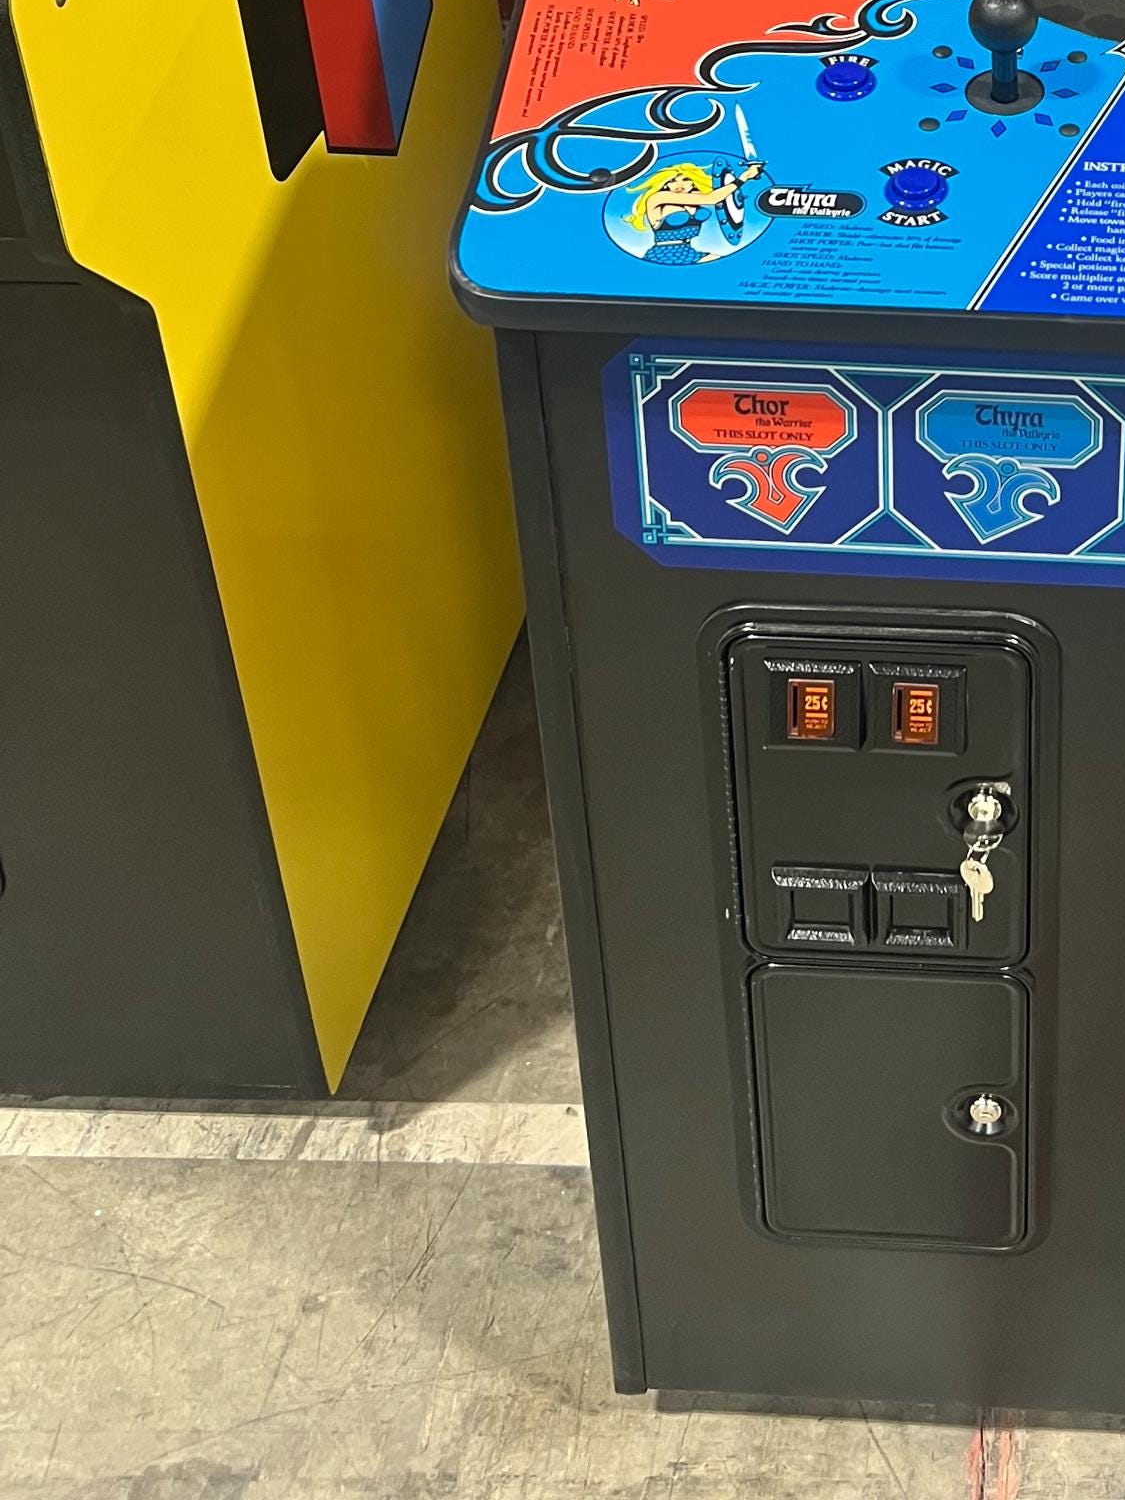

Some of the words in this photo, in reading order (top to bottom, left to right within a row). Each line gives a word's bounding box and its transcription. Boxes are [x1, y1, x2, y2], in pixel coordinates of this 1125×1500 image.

[828, 55, 871, 67] FIRE
[886, 159, 952, 177] MAGIC
[1084, 180, 1108, 189] Each
[1075, 188, 1112, 198] Players
[768, 188, 837, 215] Thyra
[1076, 199, 1102, 207] Hold
[810, 207, 851, 218] Valkyrie
[1071, 207, 1109, 216] Release
[882, 210, 941, 227] START
[1067, 215, 1098, 224] Move
[1090, 235, 1116, 244] Food
[1055, 243, 1092, 252] Collect
[1095, 246, 1125, 255] magic
[1075, 253, 1112, 262] Collect
[1039, 260, 1076, 271] Special
[1078, 263, 1117, 272] potions
[1029, 270, 1058, 280] Score
[1060, 272, 1114, 283] multiplier
[1062, 281, 1070, 290] 2
[1086, 284, 1115, 292] more
[1060, 293, 1093, 303] Game
[1095, 296, 1119, 304] over
[733, 393, 790, 416] Thor
[755, 417, 771, 426] the
[773, 417, 813, 428] Warrior
[975, 403, 1043, 431] Thyra
[713, 428, 744, 439] THIS
[745, 430, 777, 440] SLOT
[779, 431, 814, 441] ONLY
[1002, 429, 1017, 438] the
[1019, 429, 1060, 440] Valkyrie
[961, 439, 989, 449] THIS
[991, 441, 1021, 450] SLOT
[1024, 442, 1058, 452] ONLY
[805, 695, 828, 711] 25¢
[909, 699, 933, 714] 25¢
